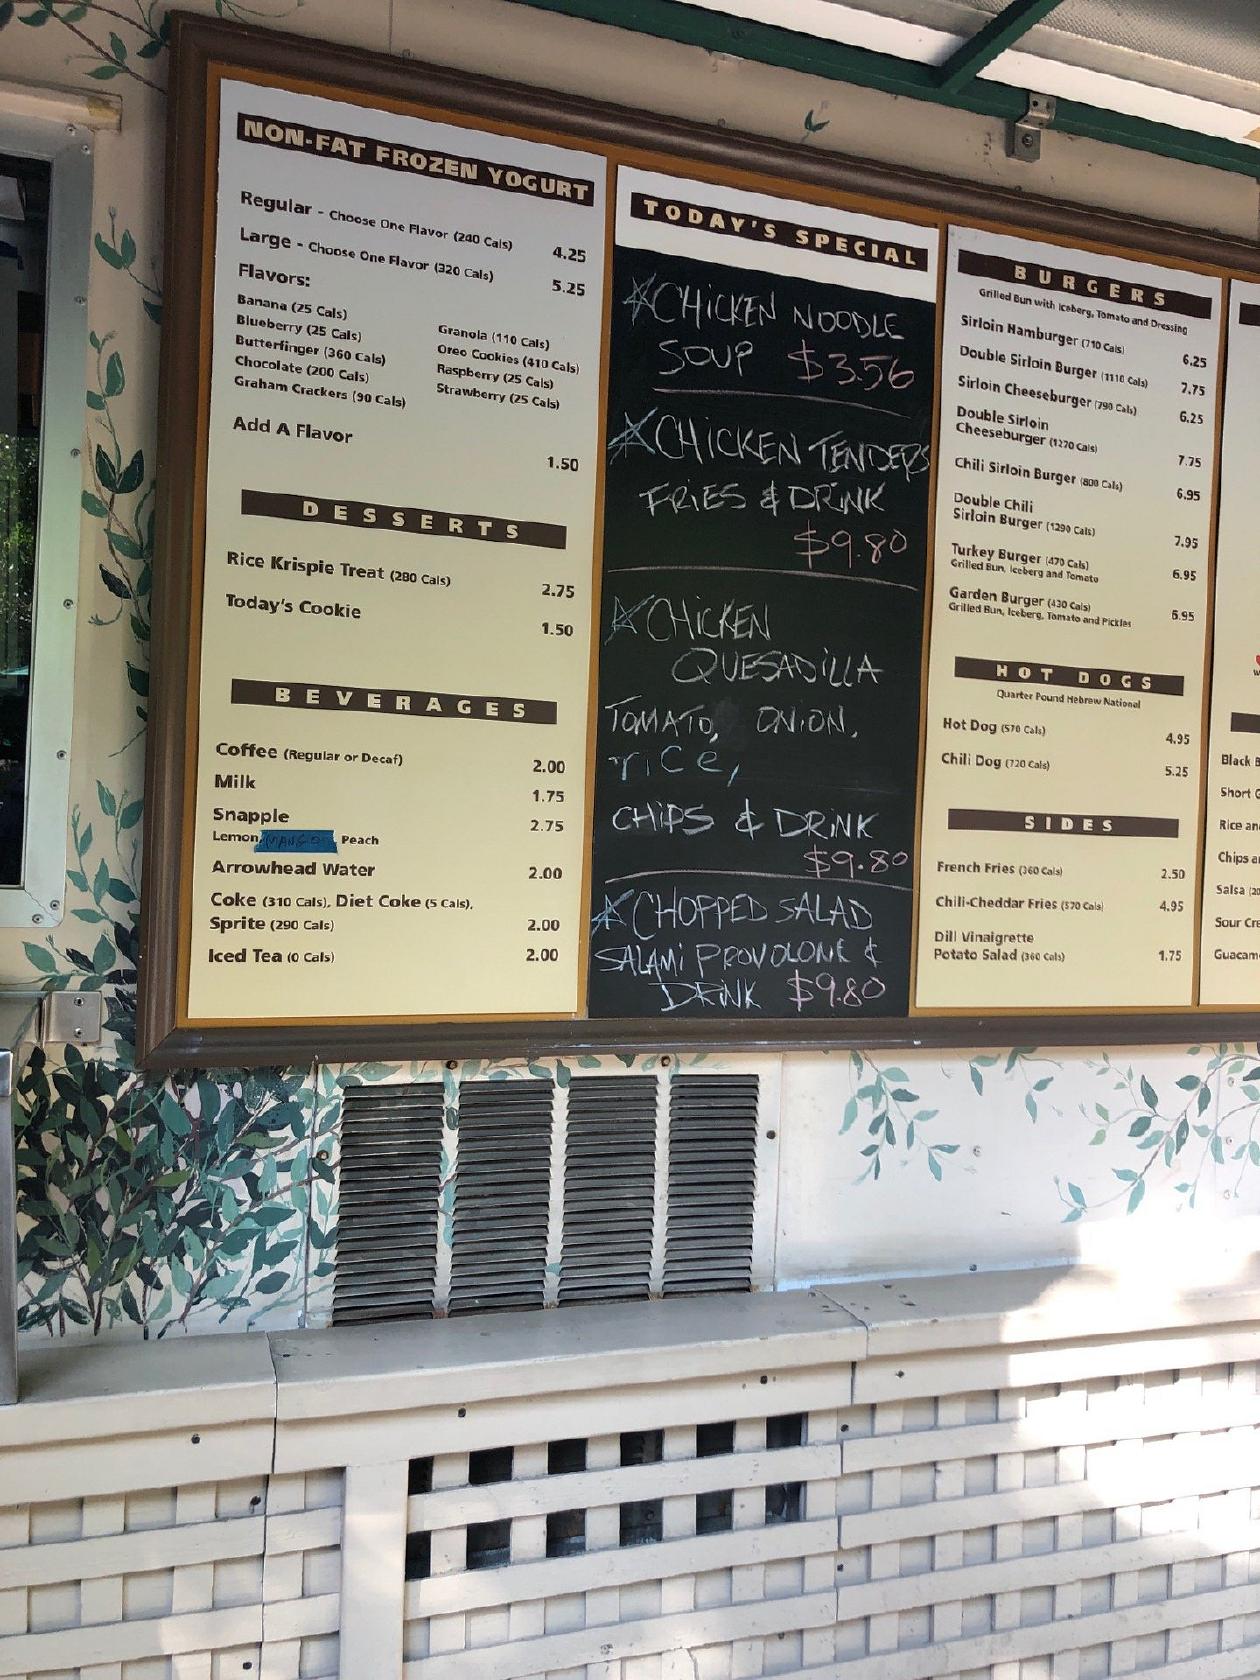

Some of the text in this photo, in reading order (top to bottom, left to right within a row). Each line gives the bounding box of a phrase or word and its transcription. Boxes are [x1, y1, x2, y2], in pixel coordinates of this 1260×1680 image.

[243, 119, 589, 200] NON-FAT FROZEN YOGURT
[240, 191, 586, 263] Regular Choose One Flavor (240 Cals) 4.25
[644, 200, 916, 265] TODAY'S SPECIAL
[240, 227, 585, 296] Large 5.25
[239, 263, 310, 287] Flavors:
[1015, 265, 1165, 306] BURGERS
[238, 294, 347, 320] Banana (25 Cals)
[979, 288, 1011, 301] Grilled
[1014, 293, 1032, 306] Bun
[1034, 297, 1055, 309] with
[1096, 310, 1130, 324] Tomato
[1132, 316, 1148, 327] and
[1151, 319, 1188, 335] Dressing
[236, 314, 303, 335] Blueberry
[438, 324, 488, 341] Granola
[794, 304, 904, 339] NOODLE
[235, 335, 319, 357] Butterfinger
[961, 315, 1003, 333] Sirloin
[1008, 323, 1078, 347] Hamburger
[1183, 354, 1207, 368] 6.25
[235, 356, 303, 374] Chocolate
[438, 345, 519, 366] Oreo Cookies
[659, 339, 915, 390] SOUP $3.56
[437, 364, 499, 383] Raspberry
[960, 346, 1205, 396] Double Sirloin Burger 7.75
[234, 376, 347, 400] Graham Crackers
[437, 383, 506, 403] Strawberry
[958, 375, 1203, 425] Sirloin Cheeseburger 6.25
[957, 406, 1049, 430] Double Sirloin
[233, 416, 579, 472] Add A Flavor 1.50
[956, 422, 1201, 467] Cheeseburger 7.75
[303, 501, 519, 540] DESSERTS
[794, 520, 907, 568] $9.80
[952, 543, 1197, 581] Turkey Burger 6.95
[227, 551, 574, 599] Rice Krispie Treat 2.75
[950, 587, 1044, 608] Garden Burger
[226, 593, 573, 637] Today's Cookie 1.50
[997, 664, 1151, 690] HOT DOGS
[275, 687, 525, 718] BEVERAGES
[997, 690, 1141, 709] Quarter Pound Hebrew National
[943, 718, 966, 731] Hot
[970, 719, 997, 735] Dog
[1166, 732, 1190, 745] 4.95
[215, 742, 565, 774] Coffee (Regular or Decaf) 2.00
[941, 753, 1189, 778] Chili Dog 5.25
[1221, 754, 1251, 767] Black
[214, 774, 565, 803] Milk 1.75
[1220, 787, 1251, 799] Short
[213, 808, 564, 833] Snapple 2.75
[1025, 815, 1112, 832] SIDES
[1220, 820, 1243, 831] Rice
[342, 835, 379, 846] Peach
[212, 860, 563, 881] Arrowhead Water 2.00
[804, 845, 908, 878] $9.80
[937, 861, 1185, 880] French Fries 2.50
[1218, 851, 1249, 865] Chips
[211, 893, 256, 907] Coke
[262, 897, 291, 908] (310
[336, 895, 374, 908] Diet
[378, 895, 421, 908] Coke
[1216, 885, 1246, 896] Salsa
[633, 887, 873, 940] CHOPPED SALAD
[936, 896, 1184, 912] Chili-Cheddar Fries 4.95
[210, 916, 560, 933] Sprite 2.00
[1215, 917, 1241, 928] Sour
[935, 931, 1034, 945] Dill Vinaigrette
[209, 948, 559, 963] Iced Tea 2.00
[697, 939, 847, 974] PROVOLONE
[934, 948, 1182, 961] Potato Salad 1.75
[786, 970, 886, 1012] $9.80
